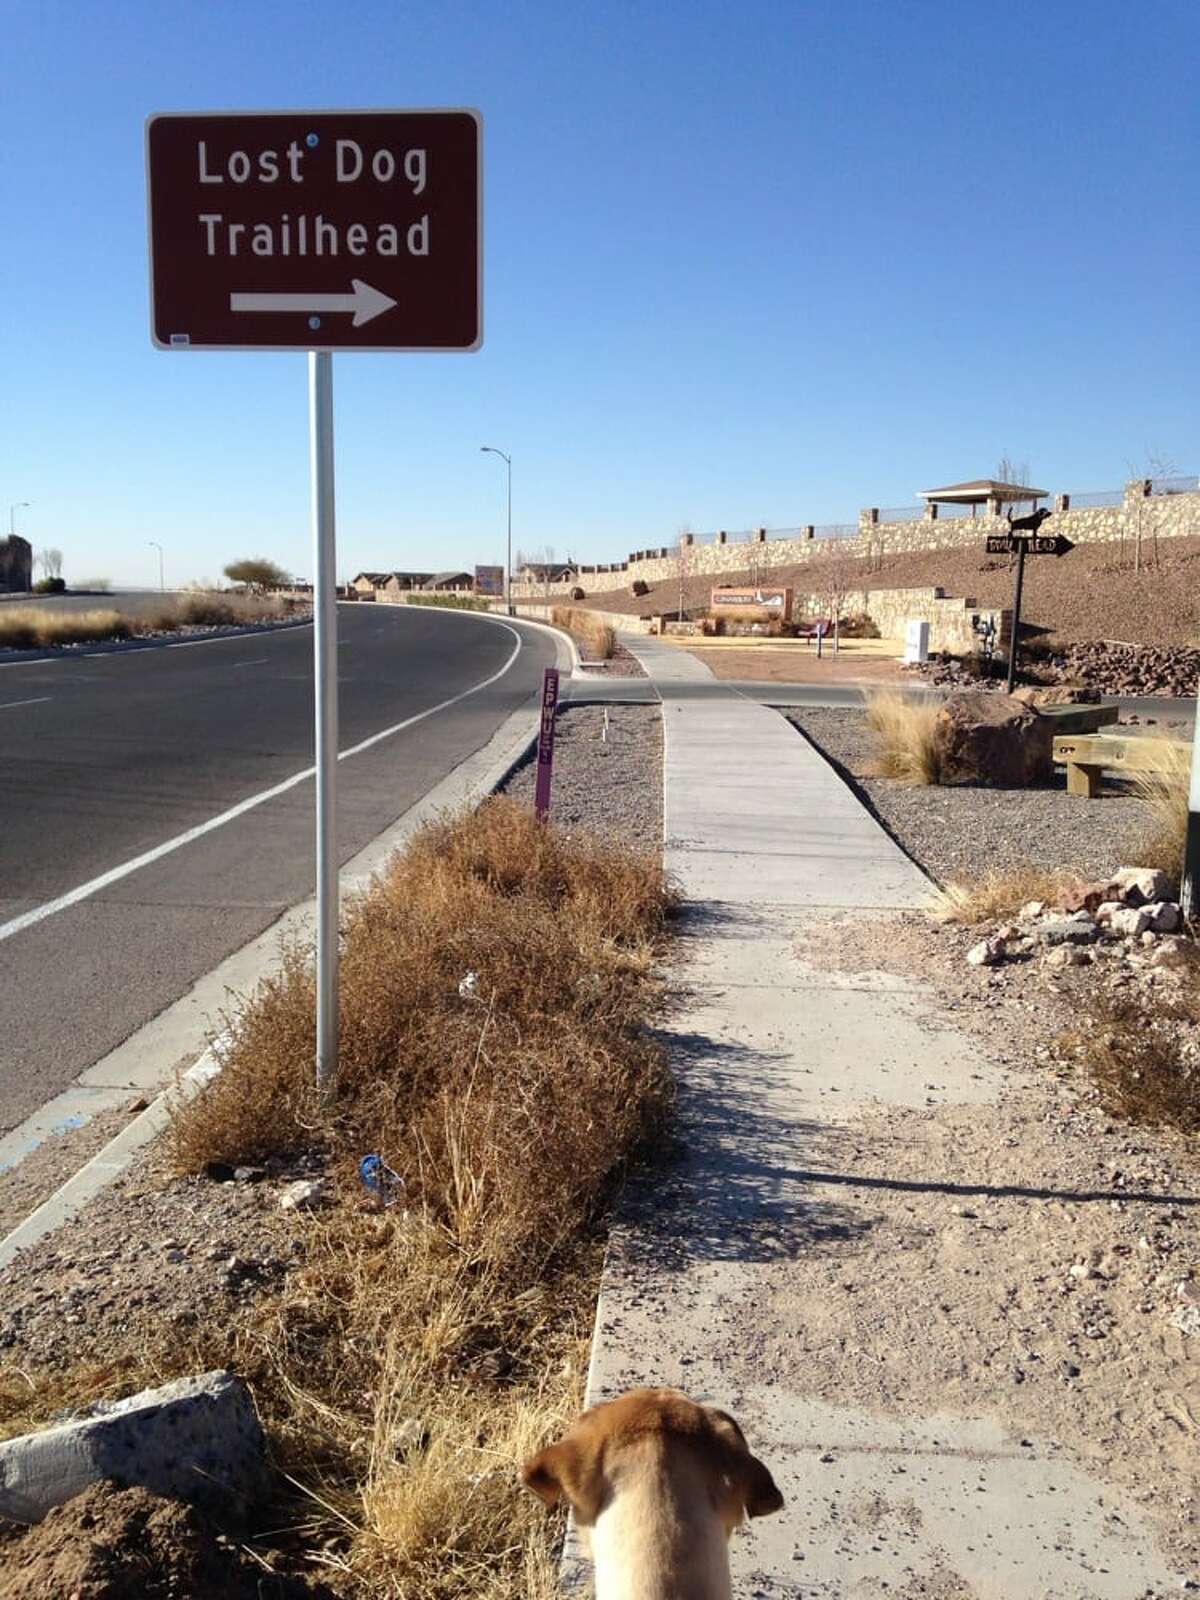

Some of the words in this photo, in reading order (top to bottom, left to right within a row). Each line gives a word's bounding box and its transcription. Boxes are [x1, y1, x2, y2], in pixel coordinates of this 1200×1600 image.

[198, 140, 304, 183] Lost
[335, 139, 427, 195] Dog
[198, 213, 430, 256] Trailhead
